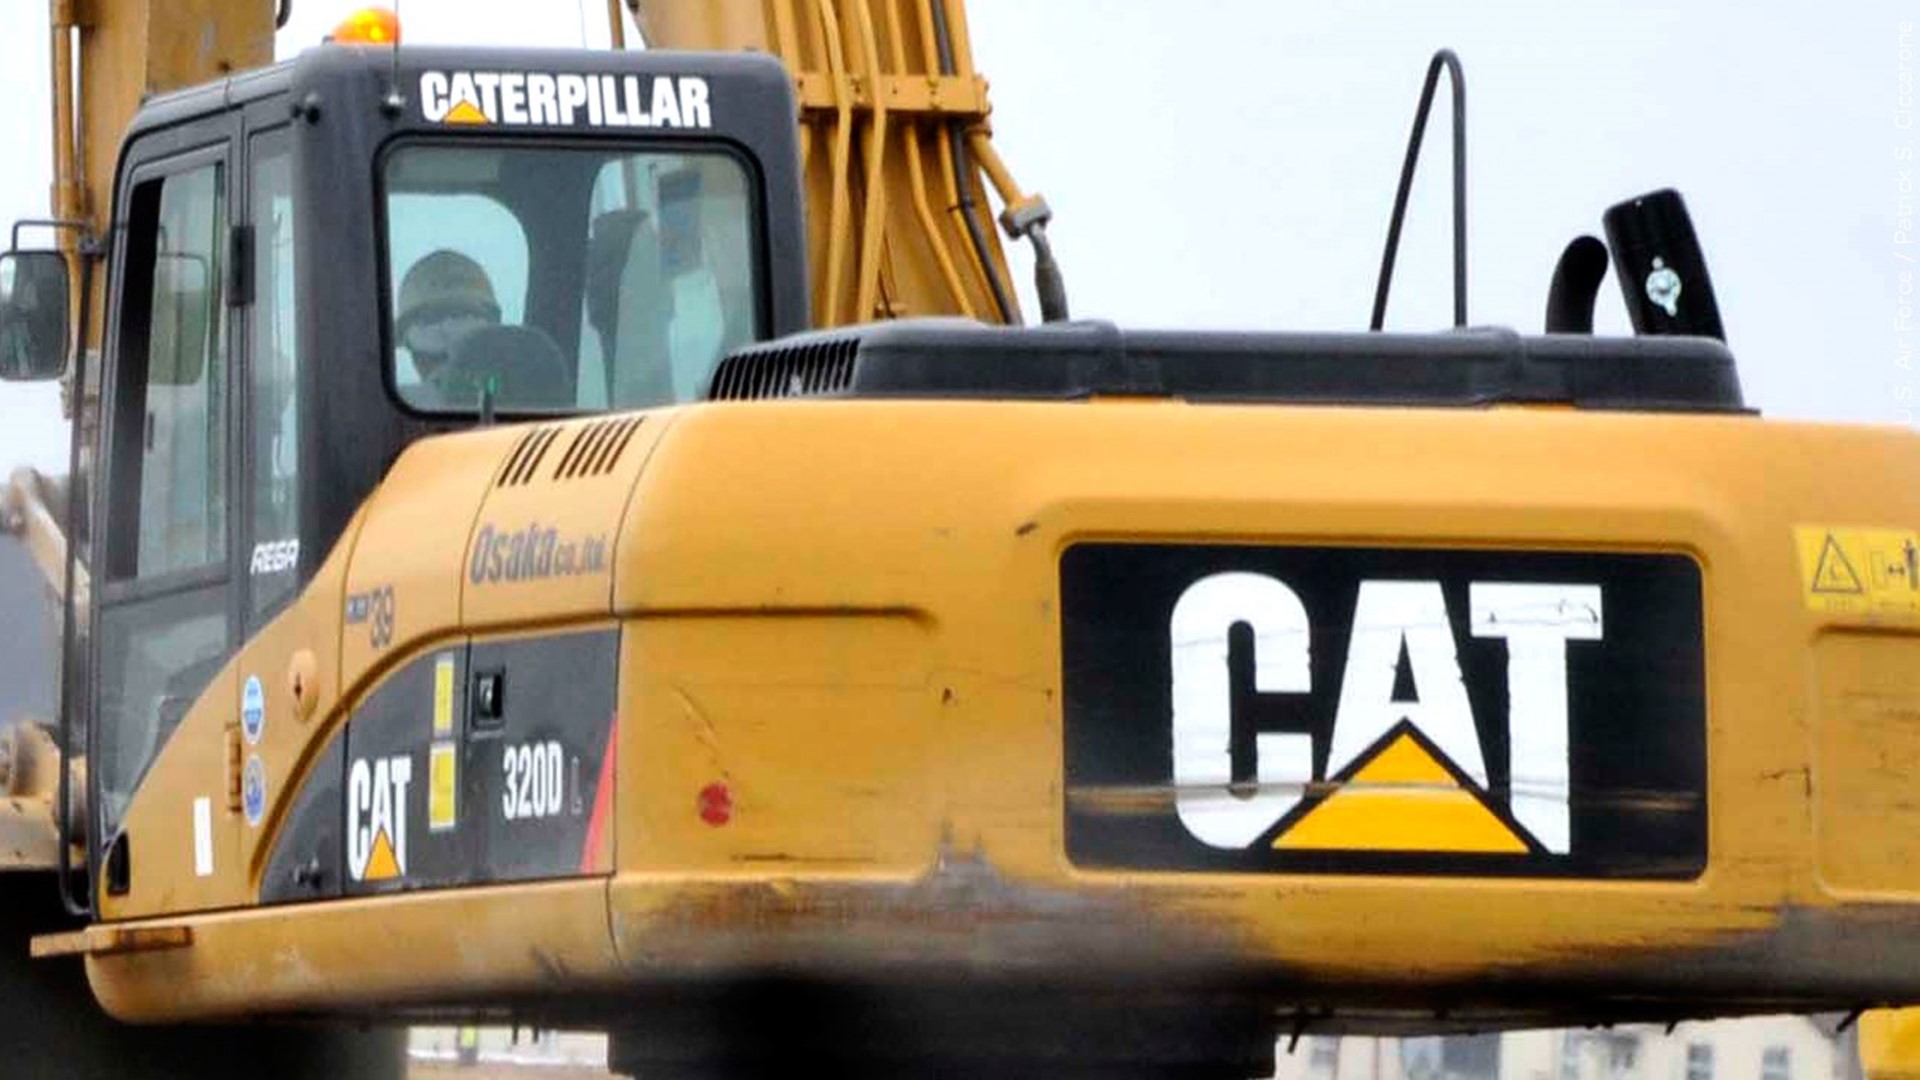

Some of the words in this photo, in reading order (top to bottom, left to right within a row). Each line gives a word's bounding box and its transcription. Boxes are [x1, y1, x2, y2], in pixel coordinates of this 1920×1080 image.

[420, 71, 711, 127] CATERPILLAR
[1171, 572, 1602, 854] CAT
[347, 755, 411, 881] CAT
[503, 740, 562, 820] 320D
